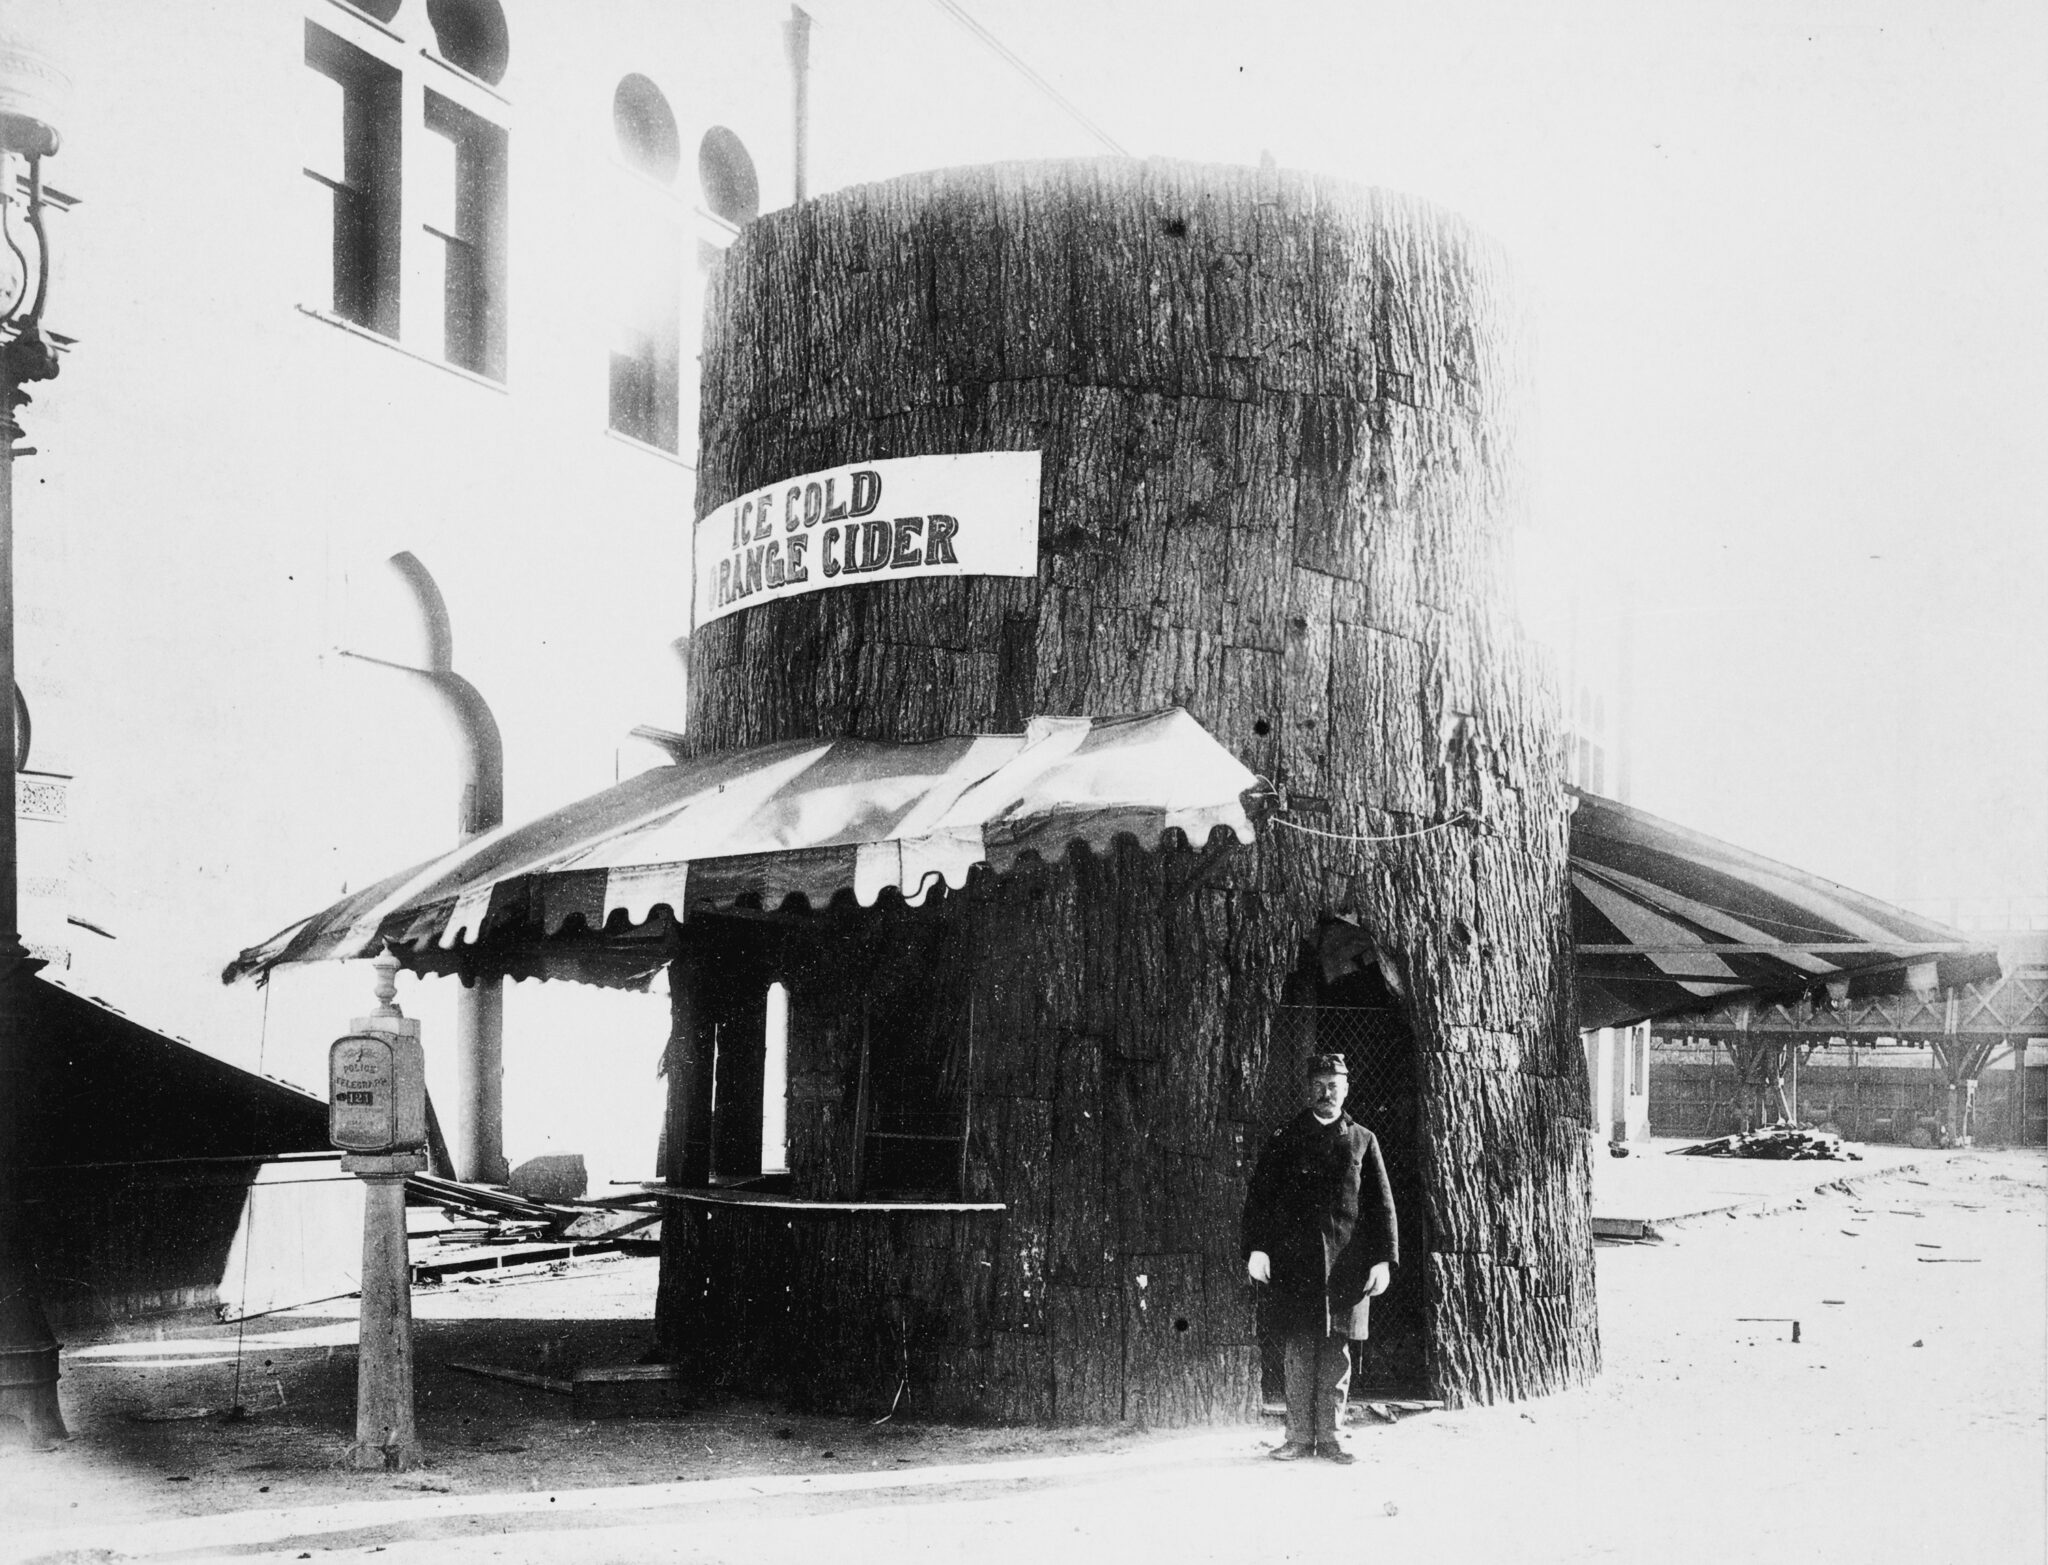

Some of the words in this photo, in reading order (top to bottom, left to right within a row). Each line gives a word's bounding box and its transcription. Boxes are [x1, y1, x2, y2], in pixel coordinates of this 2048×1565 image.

[732, 494, 773, 549] ICE
[785, 470, 882, 533] COLD
[822, 514, 959, 578] CIDER
[343, 1064, 377, 1074] POLICE
